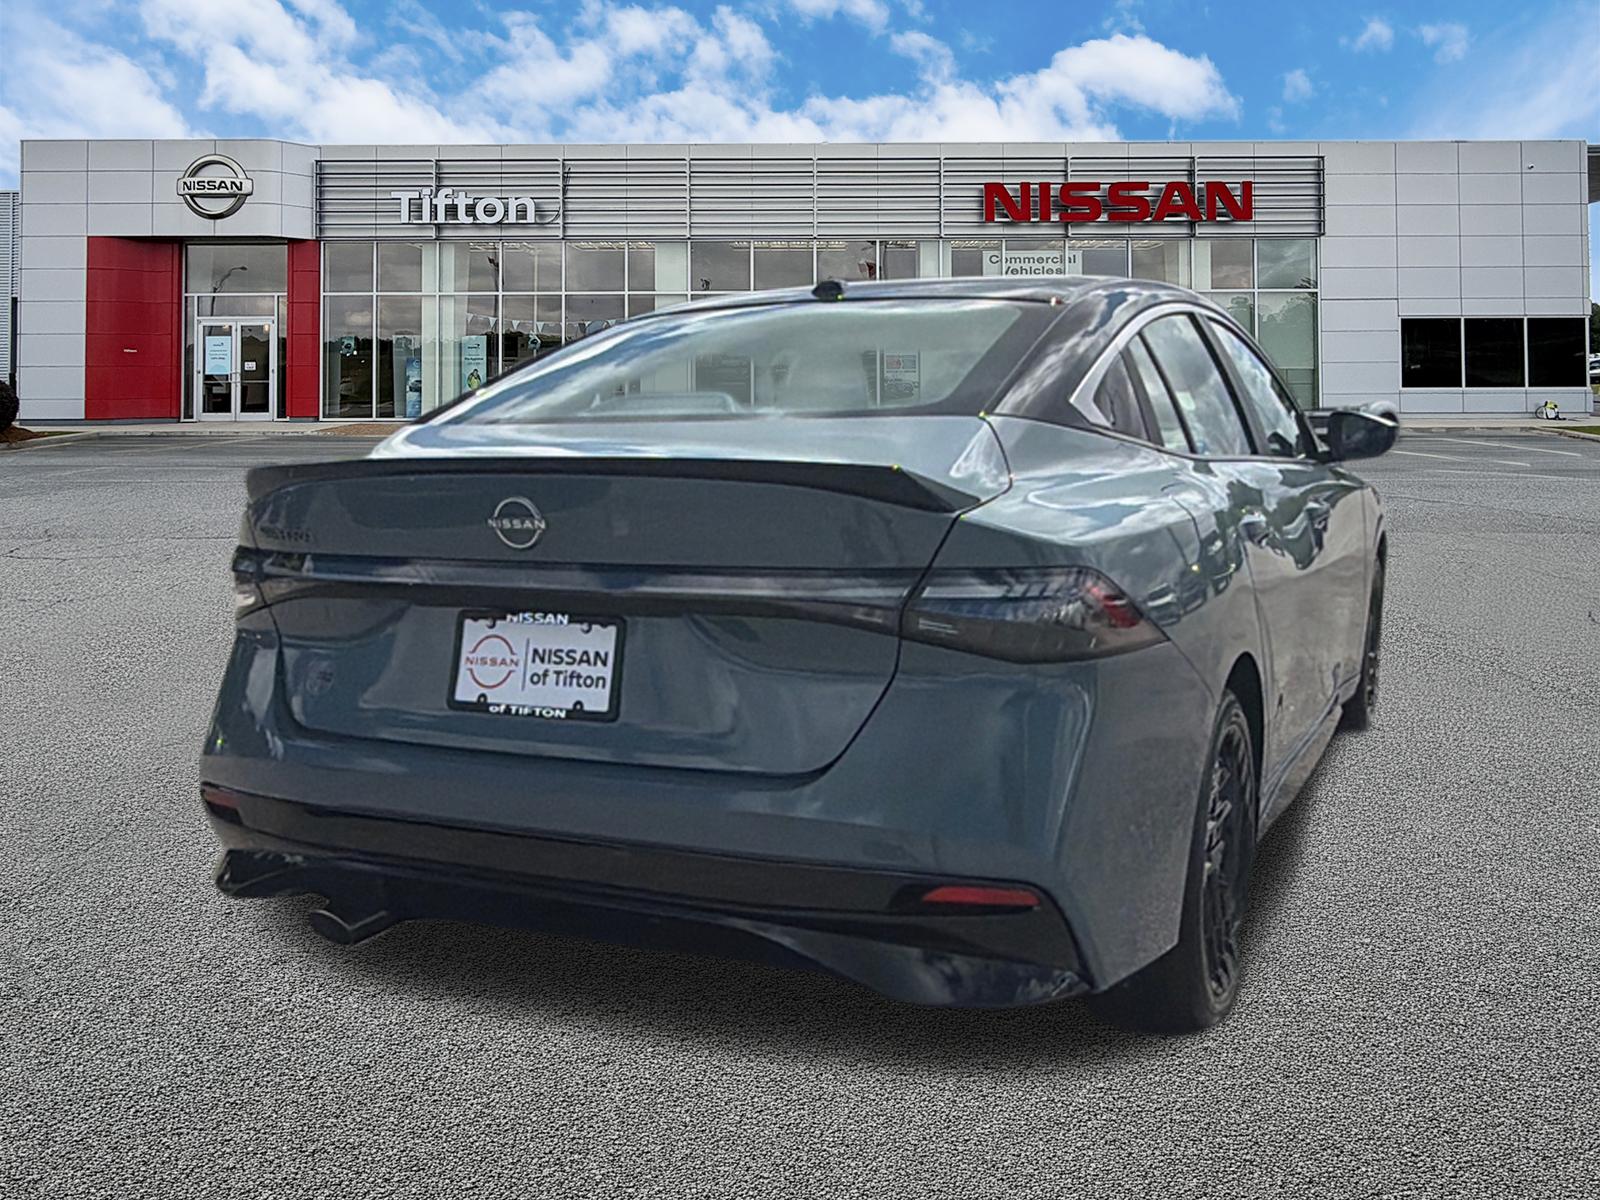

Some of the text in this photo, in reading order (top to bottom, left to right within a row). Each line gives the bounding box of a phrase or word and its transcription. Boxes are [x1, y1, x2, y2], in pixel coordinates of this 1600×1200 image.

[182, 180, 243, 191] NISSAN
[391, 188, 536, 224] Tifton
[984, 180, 1254, 222] NISSAN
[989, 254, 1077, 265] Cmmercil
[487, 518, 546, 529] NISSAN
[506, 612, 569, 625] NISSAN
[464, 656, 519, 667] NISSAN
[531, 647, 608, 667] NISSAN
[530, 669, 606, 689] of Tifton
